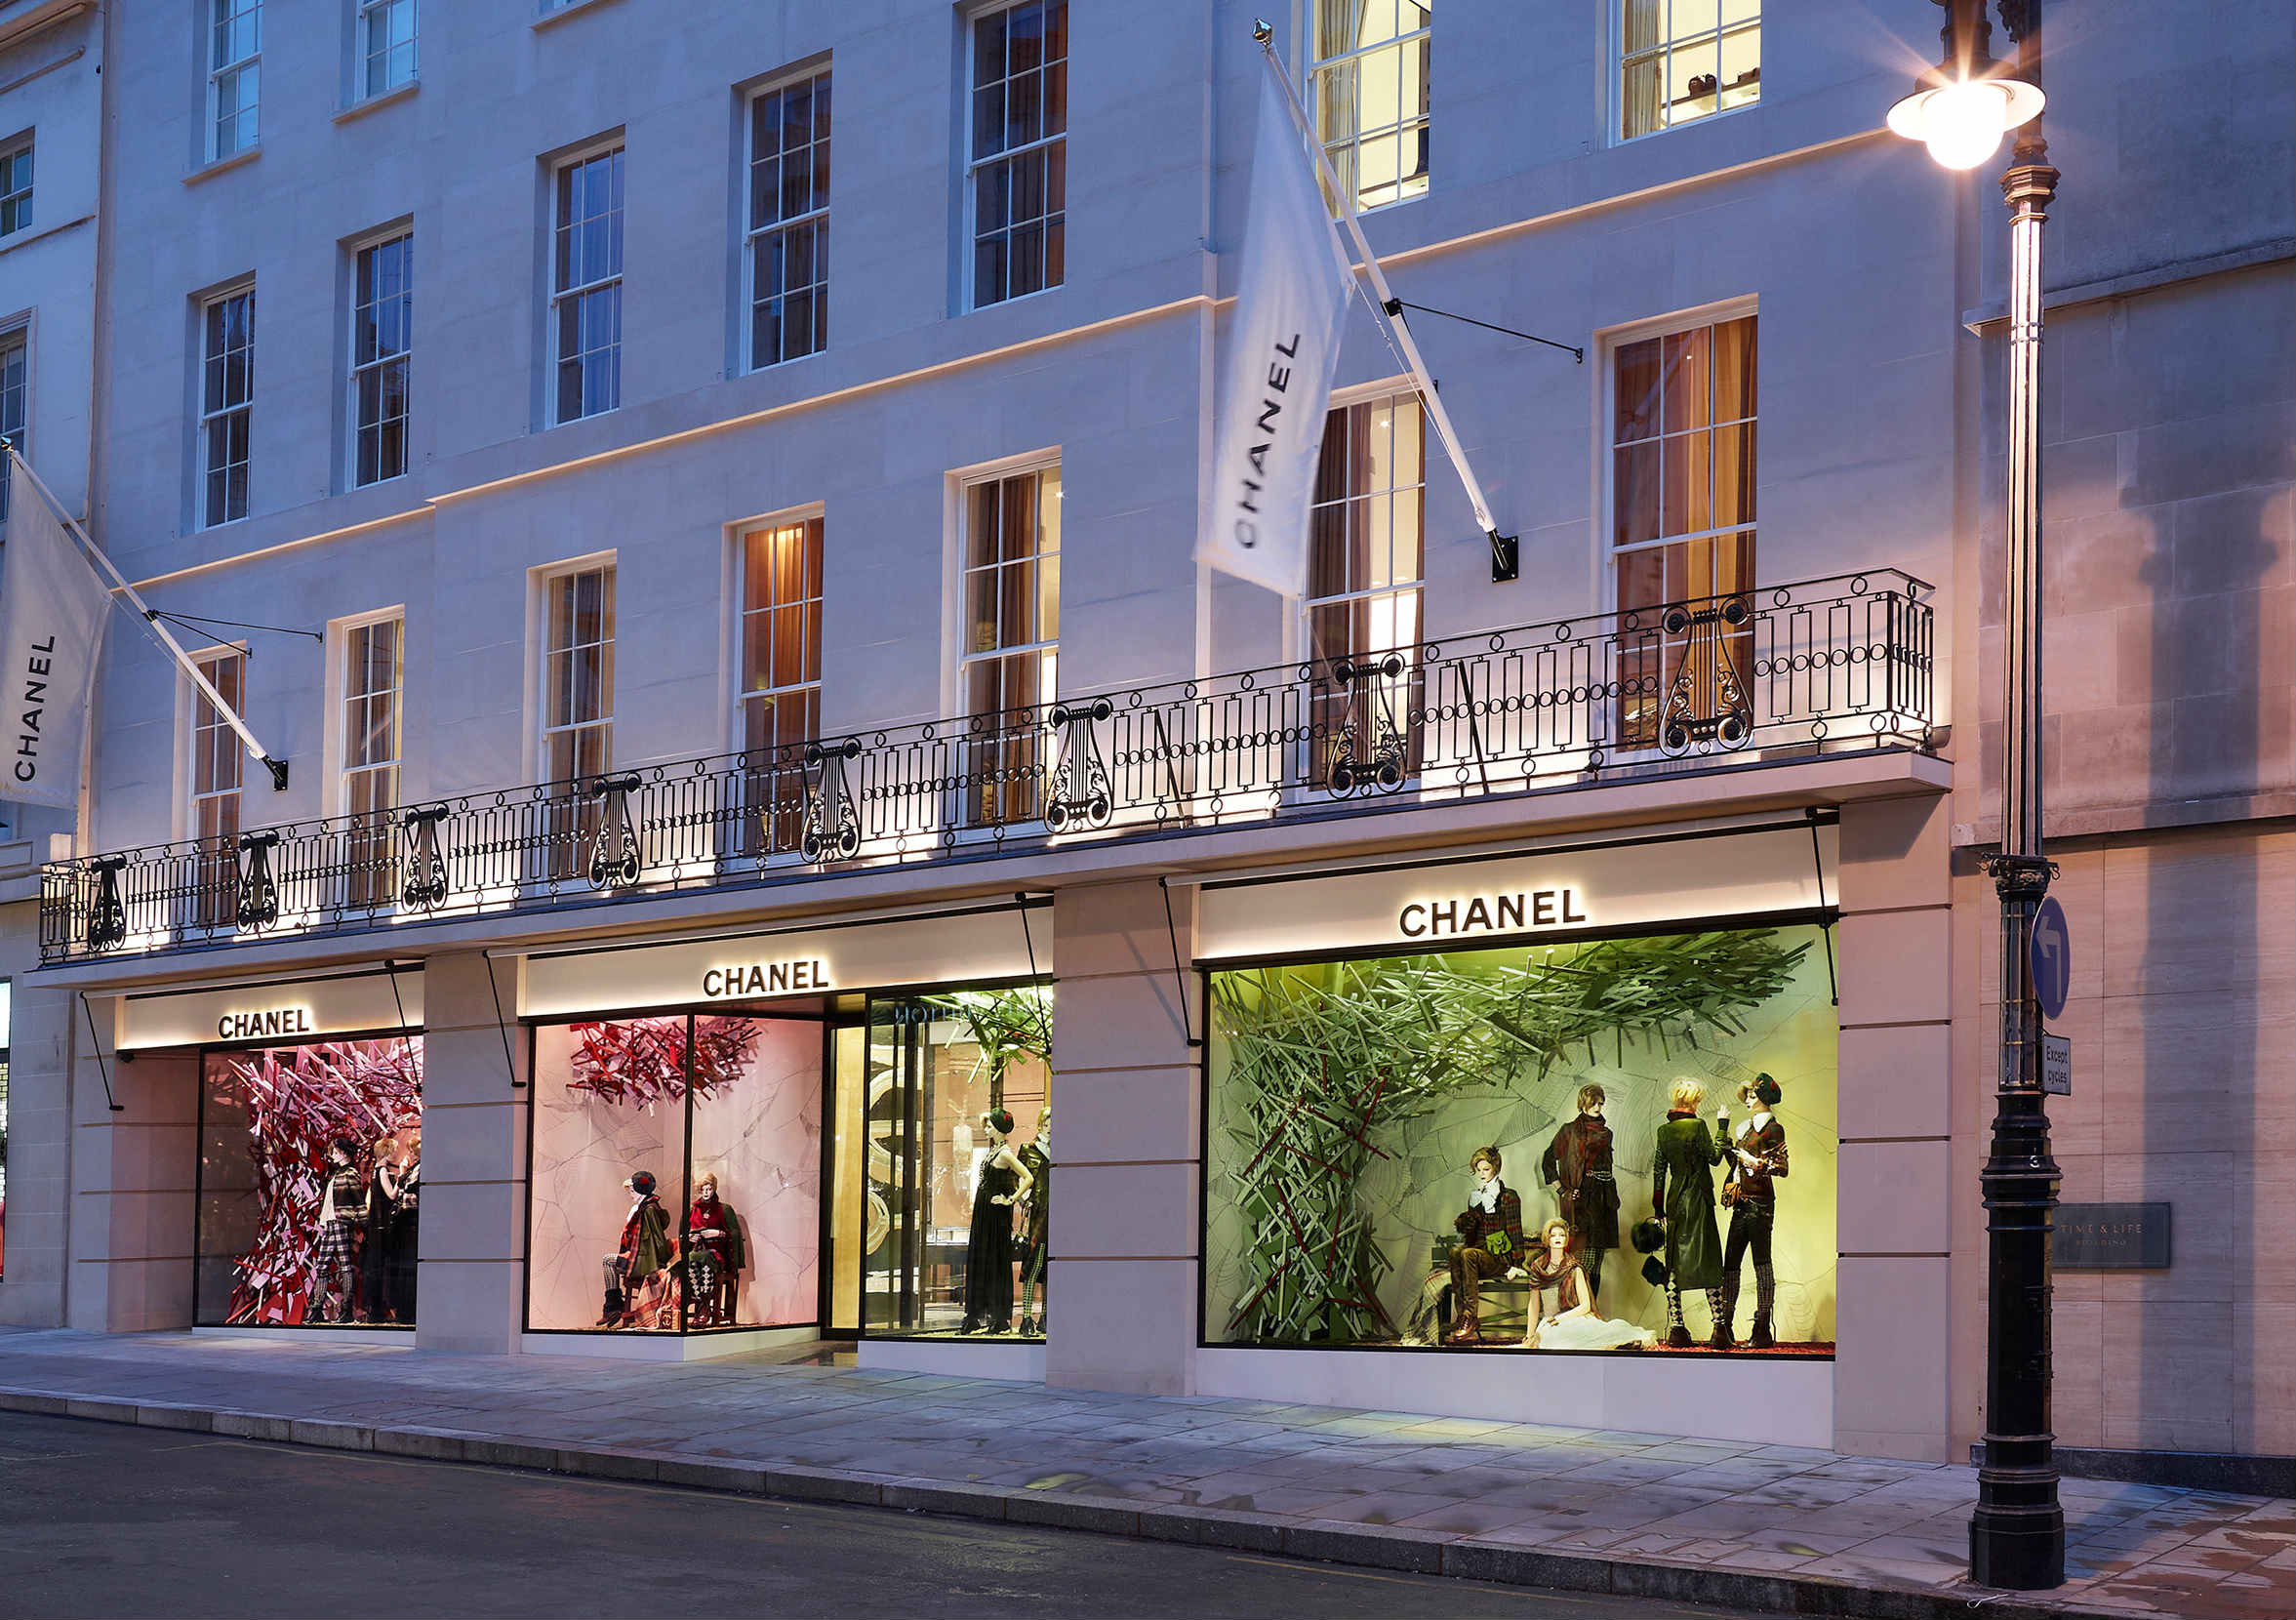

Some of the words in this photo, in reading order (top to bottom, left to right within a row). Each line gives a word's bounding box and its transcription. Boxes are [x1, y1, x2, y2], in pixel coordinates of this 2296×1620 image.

[1234, 334, 1300, 549] CHANEL
[15, 635, 56, 782] CHANEL
[1399, 889, 1587, 938] CHANEL
[703, 960, 829, 997] CHANEL
[218, 1009, 310, 1039] CHANEL
[2046, 1045, 2069, 1065] Except
[2047, 1069, 2068, 1084] cycles
[2060, 1224, 2094, 1235] TIME
[2099, 1224, 2109, 1235] &
[2113, 1223, 2143, 1235] LIFE
